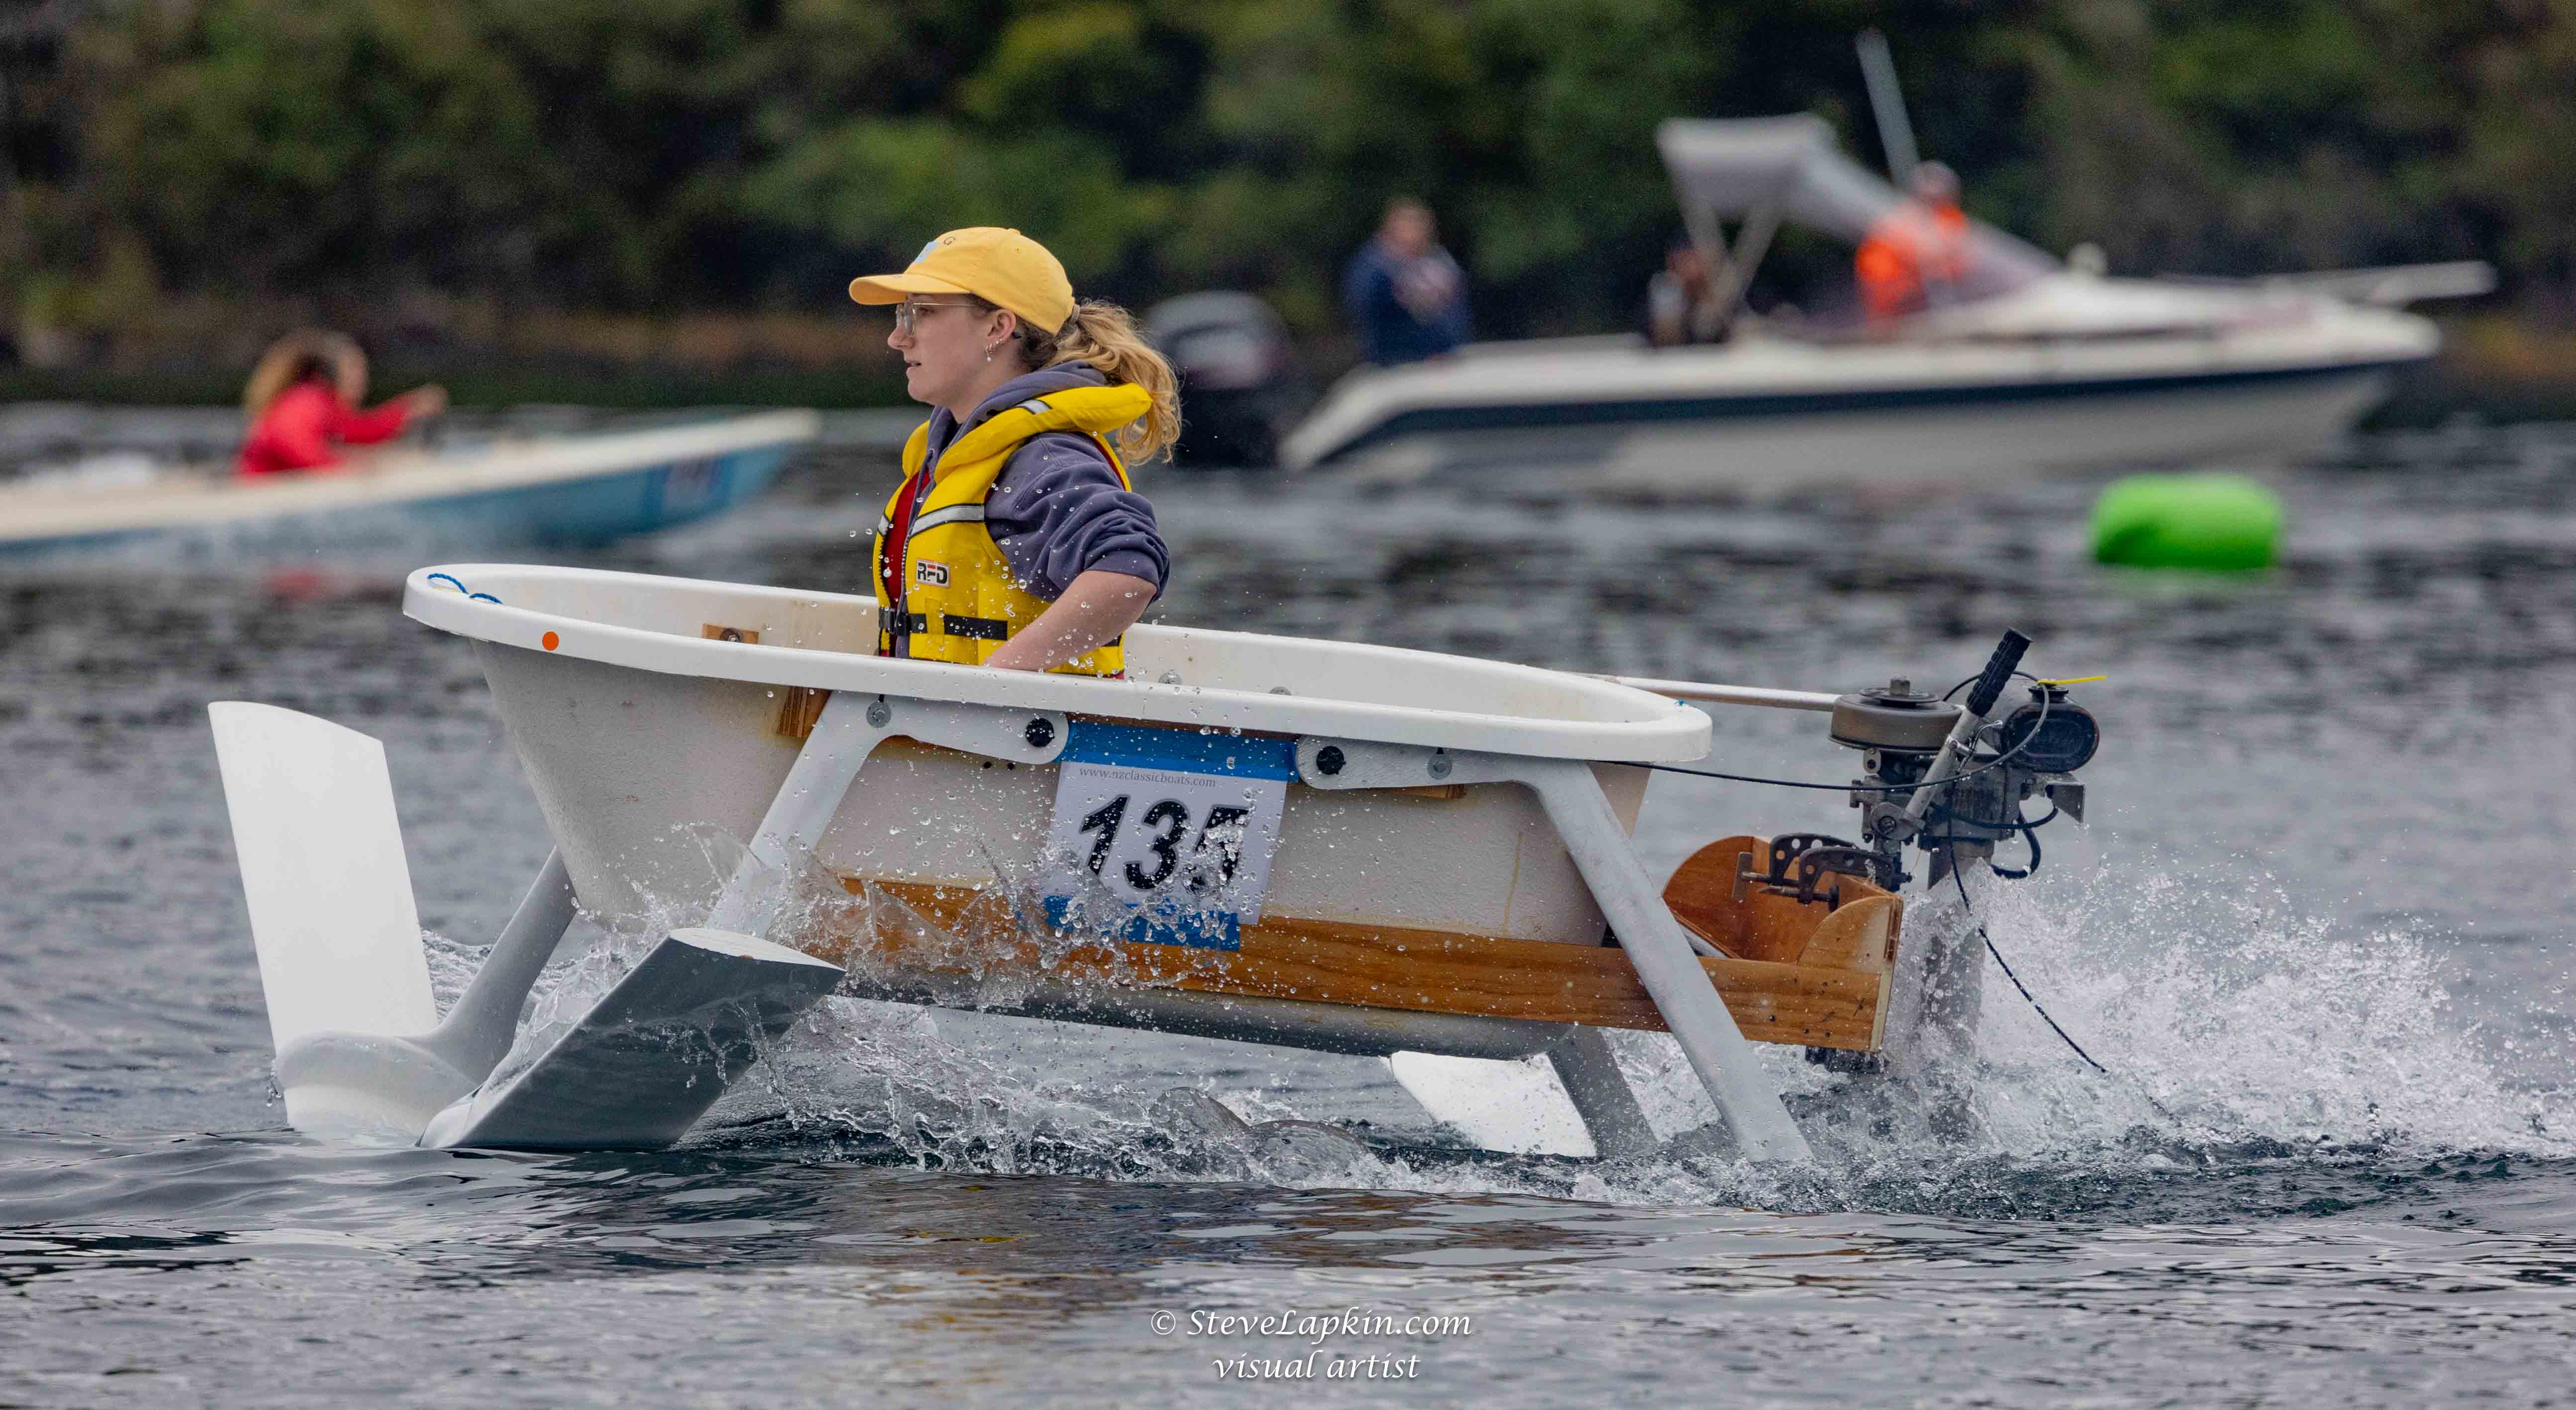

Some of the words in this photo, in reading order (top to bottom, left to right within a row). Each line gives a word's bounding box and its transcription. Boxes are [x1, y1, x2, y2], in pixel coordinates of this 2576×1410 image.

[917, 562, 948, 584] RFD
[1079, 767, 1216, 787] www.nzclassicboats.com
[1079, 794, 1255, 893] 135
